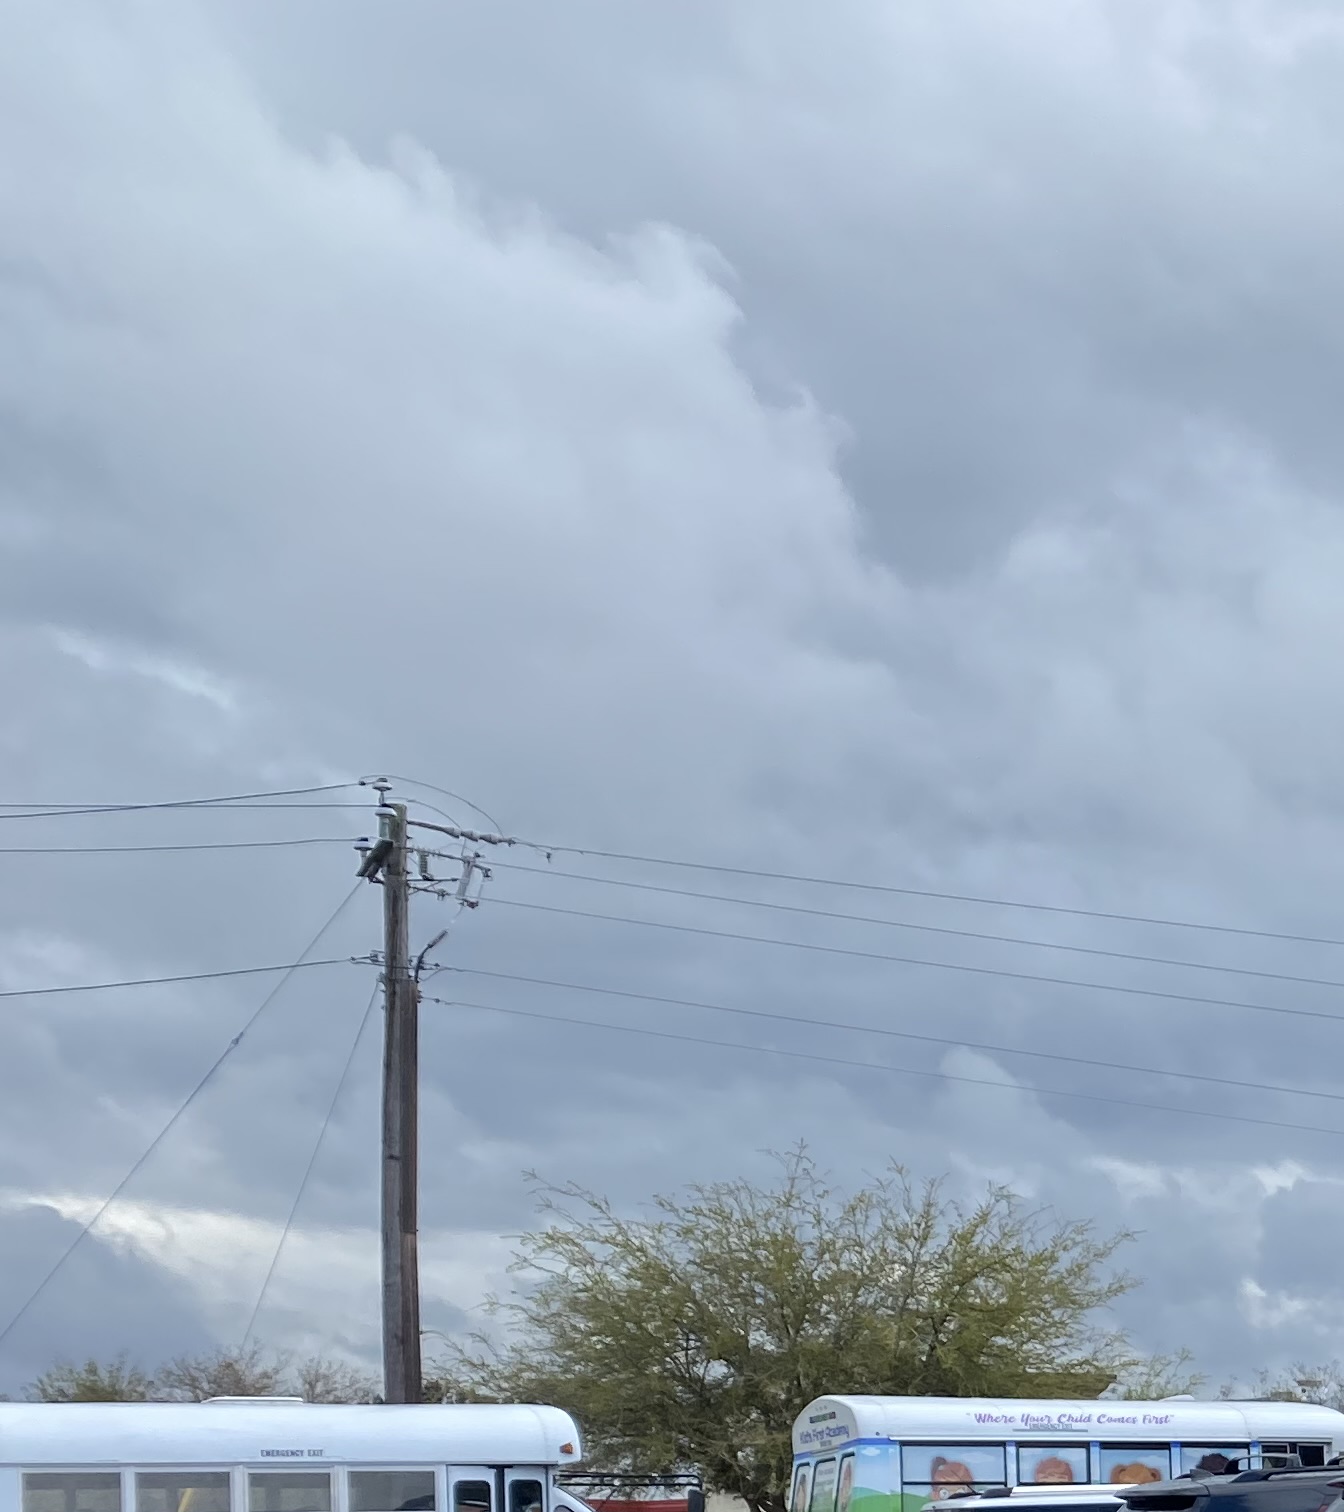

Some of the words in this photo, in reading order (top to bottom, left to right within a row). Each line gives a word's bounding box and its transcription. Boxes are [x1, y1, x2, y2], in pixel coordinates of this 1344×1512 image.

[1020, 1413, 1051, 1428] Your
[1057, 1413, 1091, 1424] Child
[1096, 1413, 1137, 1424] Comes
